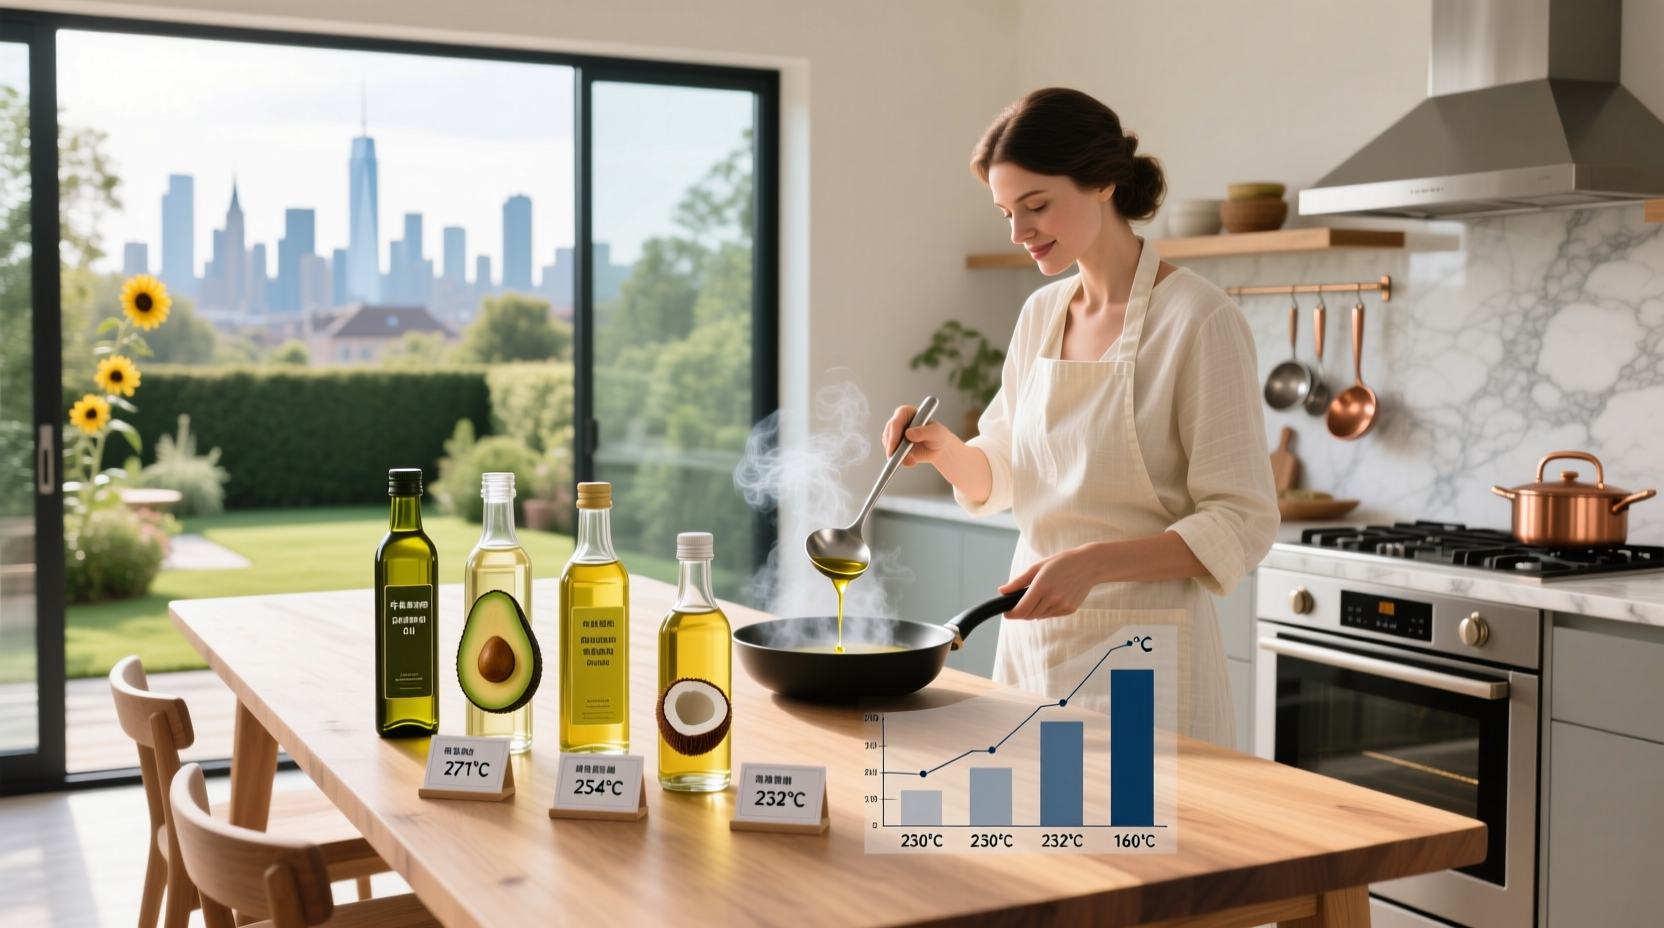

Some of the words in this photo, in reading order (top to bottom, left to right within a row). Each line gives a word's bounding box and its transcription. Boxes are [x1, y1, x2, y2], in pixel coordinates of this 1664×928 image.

[444, 761, 490, 777] 271°C
[573, 779, 624, 796] 254°C
[754, 790, 806, 808] 232°C
